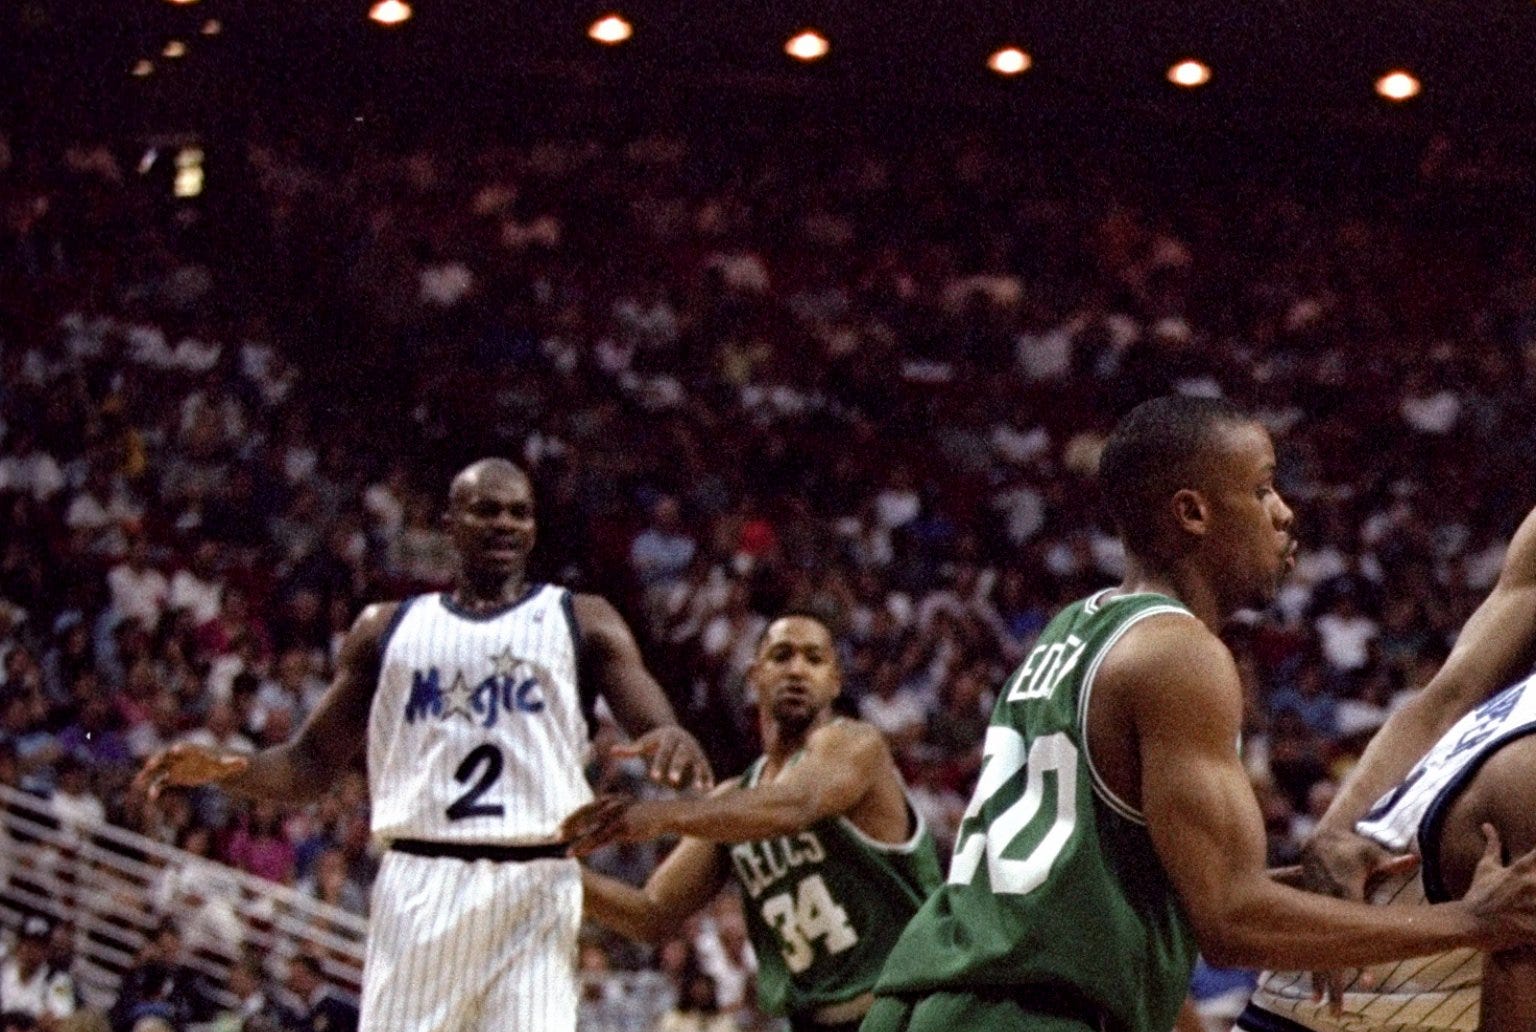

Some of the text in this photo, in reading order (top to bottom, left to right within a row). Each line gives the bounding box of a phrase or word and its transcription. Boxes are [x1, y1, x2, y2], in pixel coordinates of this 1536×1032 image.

[446, 742, 505, 822] 2
[947, 725, 1078, 895] 20
[761, 873, 860, 974] 34
